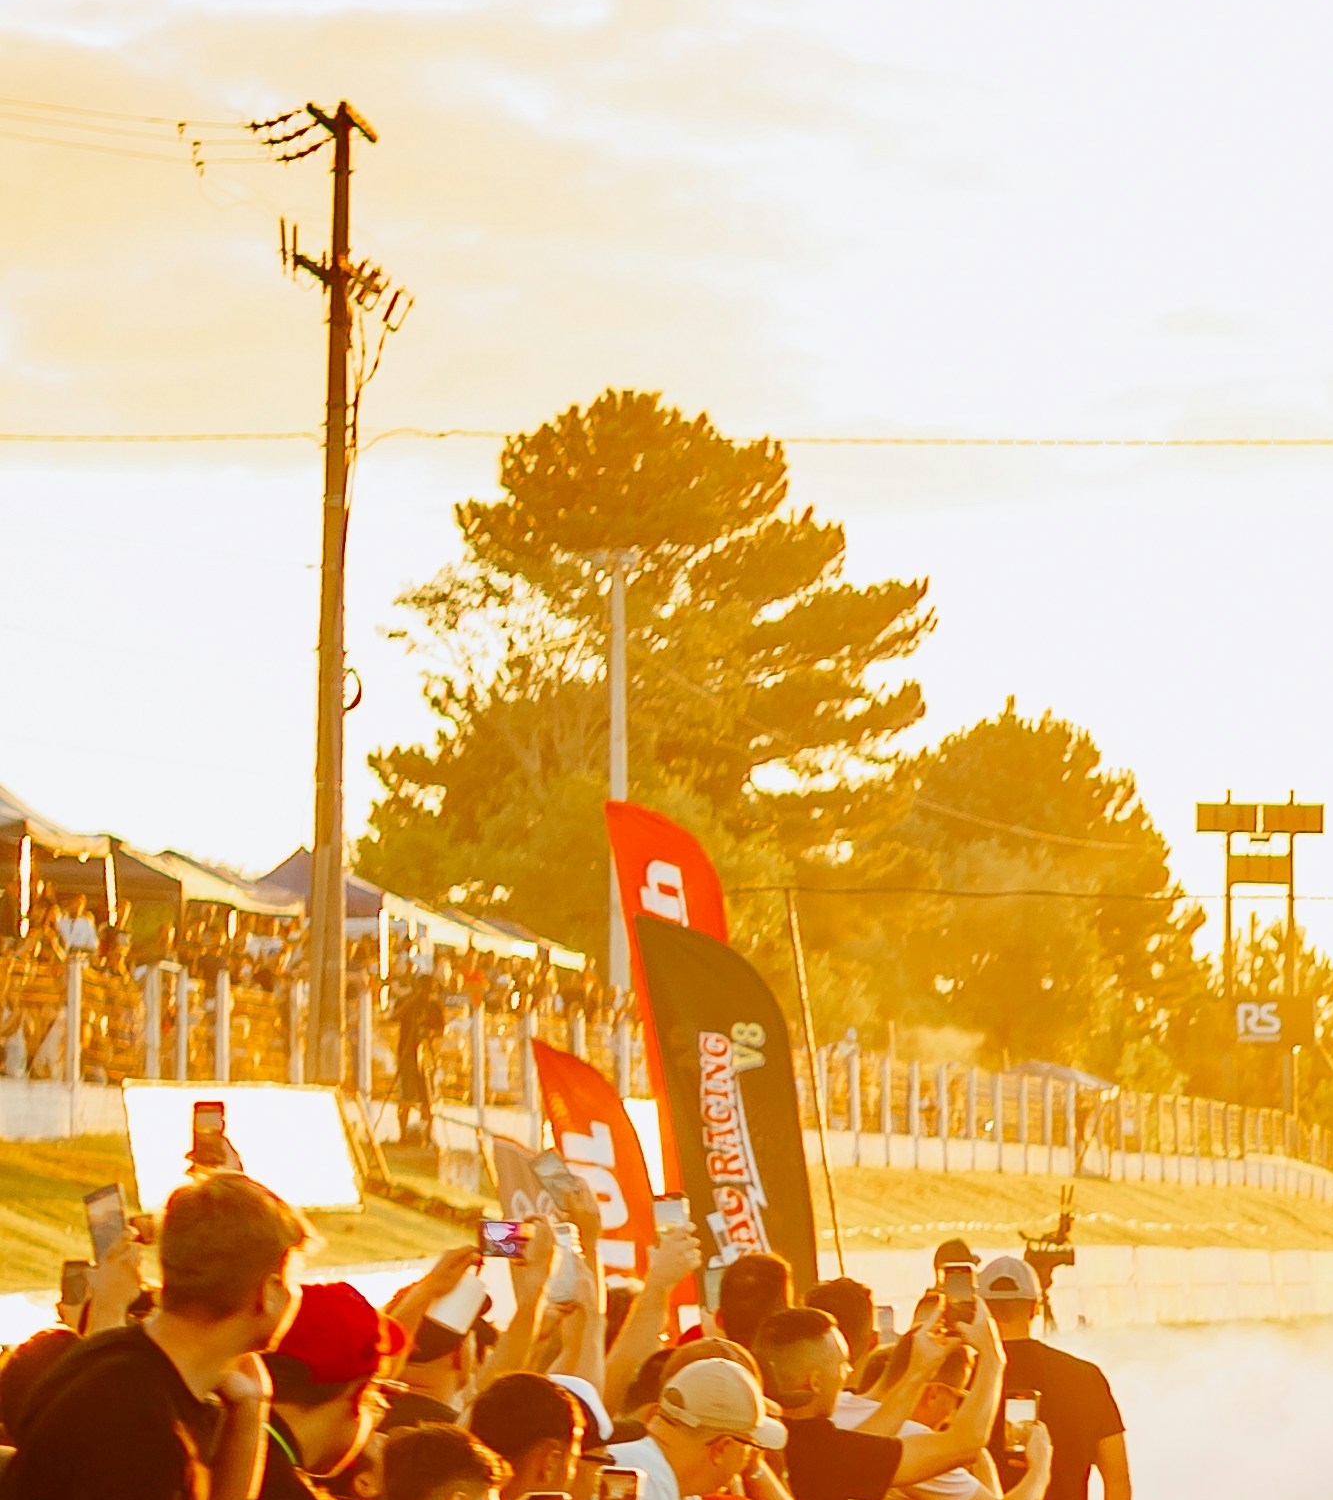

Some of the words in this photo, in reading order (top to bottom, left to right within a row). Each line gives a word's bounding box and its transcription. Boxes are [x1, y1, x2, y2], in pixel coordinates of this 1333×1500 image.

[1236, 1002, 1281, 1034] RS
[731, 1021, 767, 1071] V8
[699, 1031, 748, 1185] RACING
